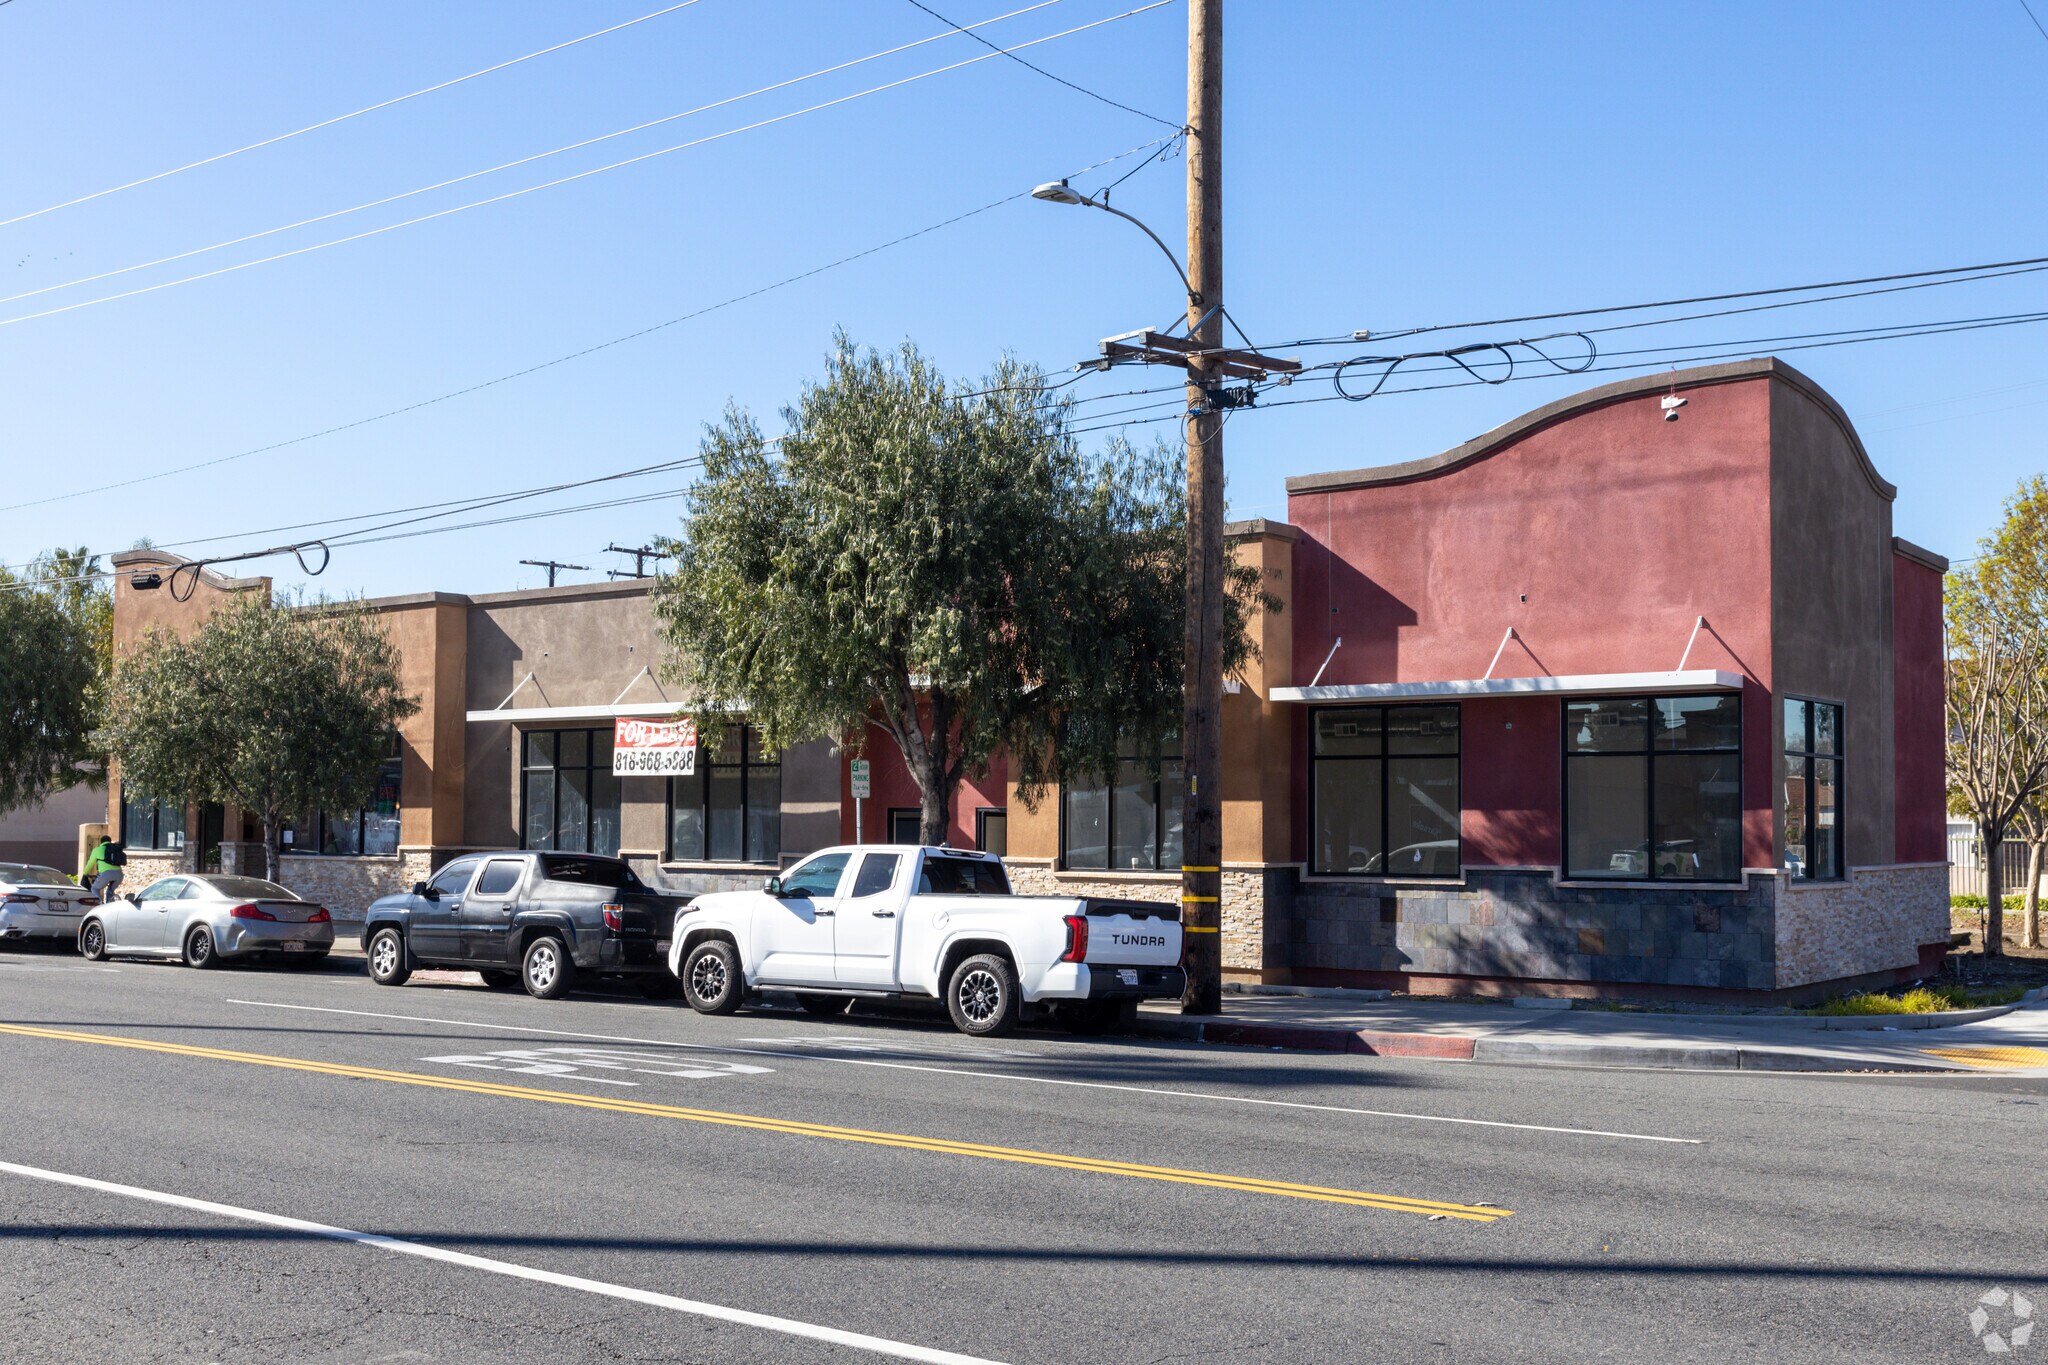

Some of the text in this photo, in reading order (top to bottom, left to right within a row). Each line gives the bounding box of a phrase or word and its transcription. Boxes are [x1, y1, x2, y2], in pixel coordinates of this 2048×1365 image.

[616, 721, 647, 744] FOR
[852, 774, 869, 782] PARKING
[1112, 934, 1165, 947] TUNDRA
[965, 962, 989, 970] MICHELIN
